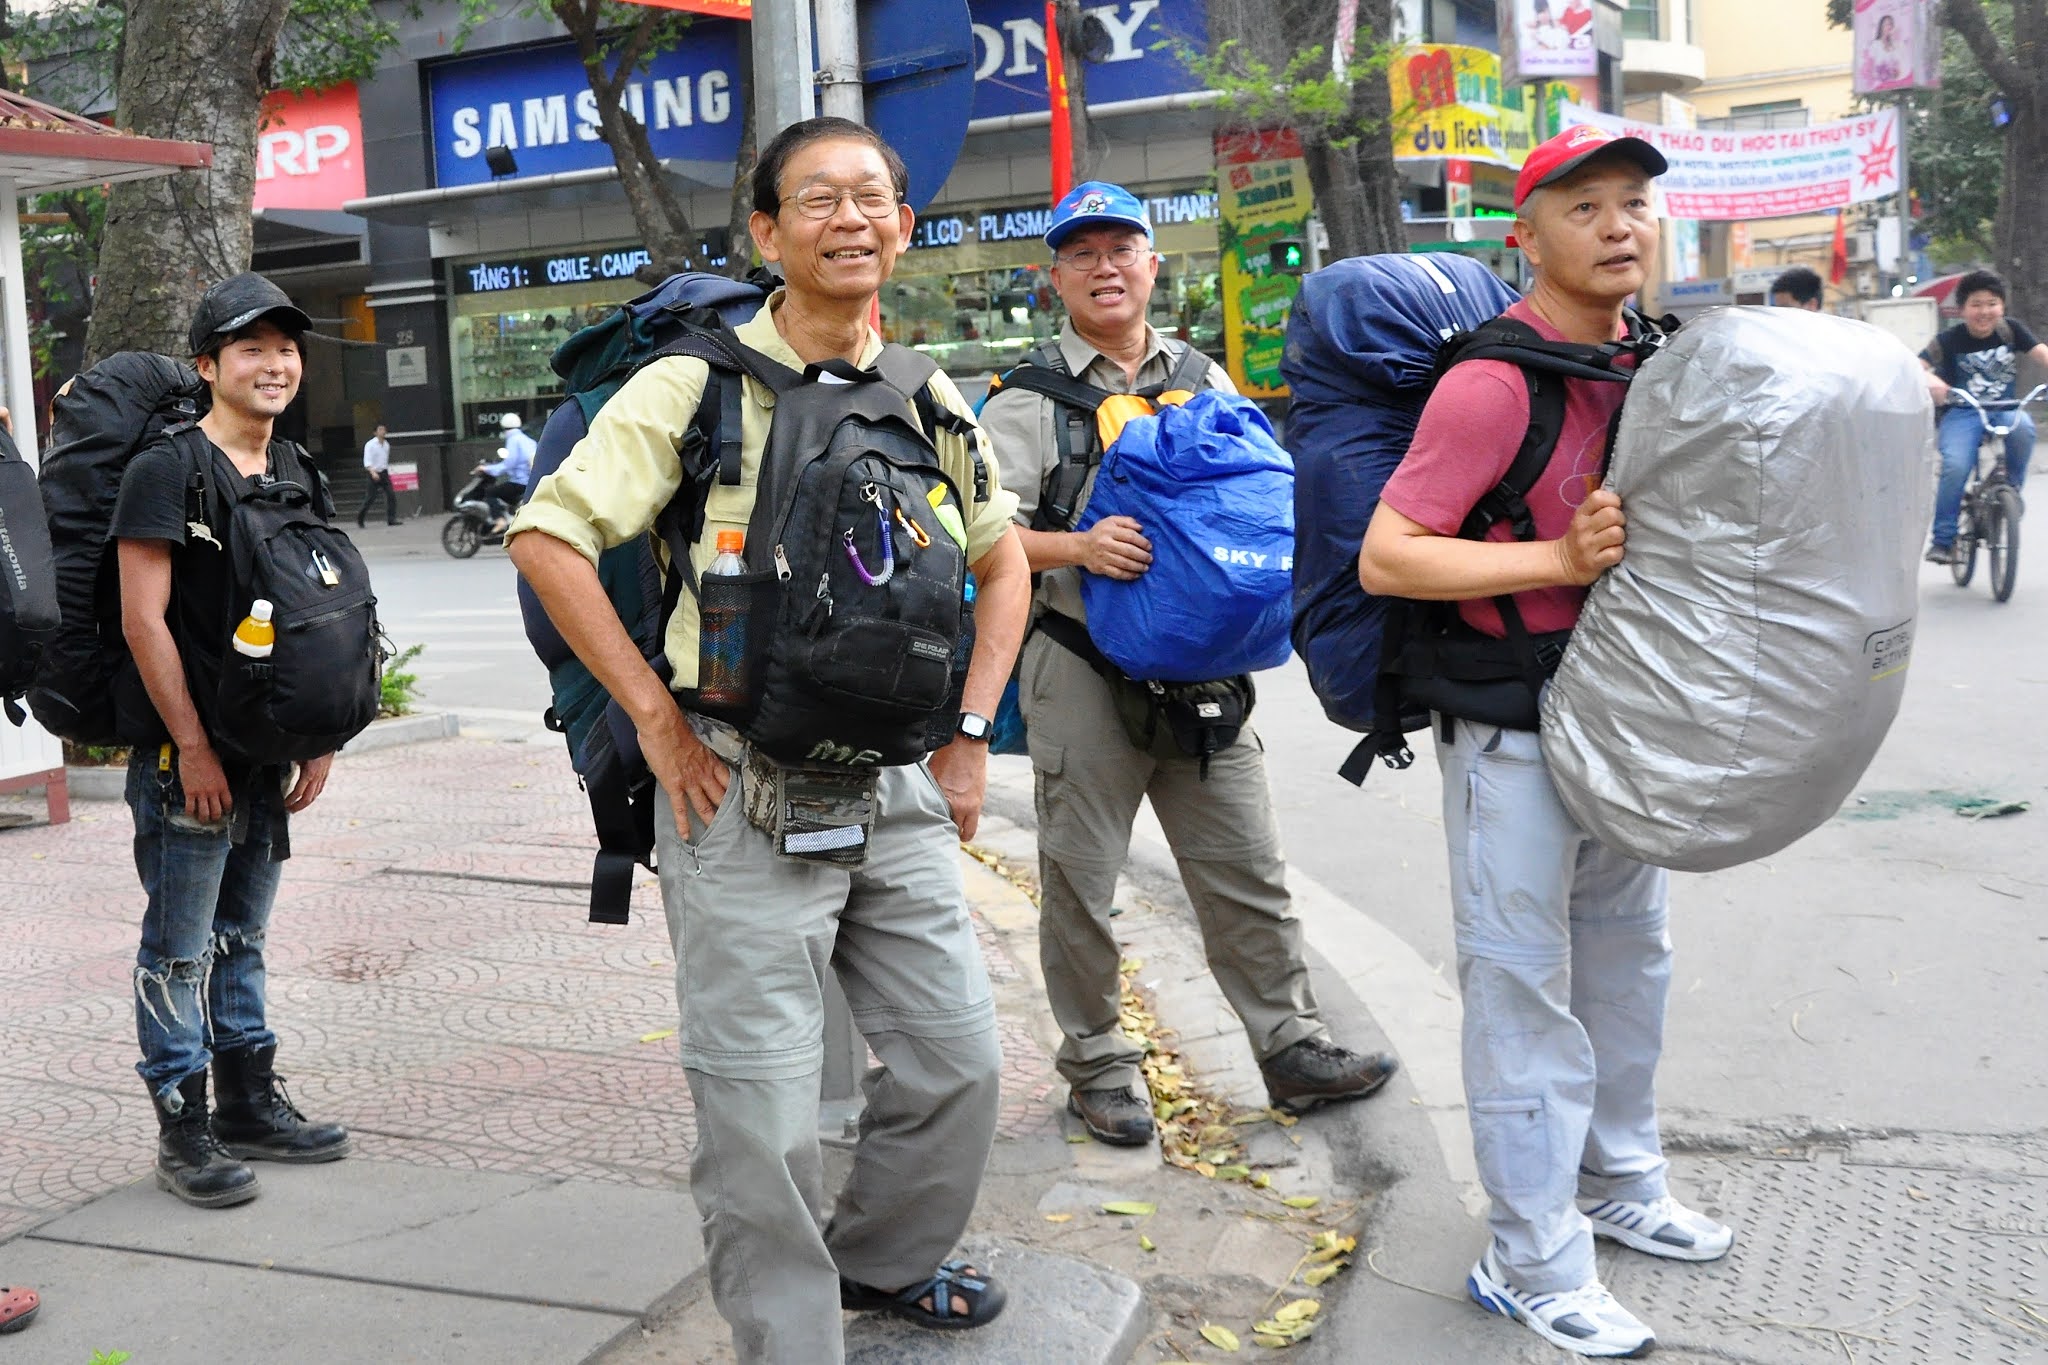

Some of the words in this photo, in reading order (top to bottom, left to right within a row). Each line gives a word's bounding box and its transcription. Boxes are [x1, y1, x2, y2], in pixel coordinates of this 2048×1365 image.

[256, 124, 350, 180] RP
[1414, 124, 1445, 152] du
[927, 217, 963, 246] LCD
[979, 208, 1055, 241] PLASMA
[547, 255, 592, 283] OBILE
[1213, 546, 1268, 570] SKY
